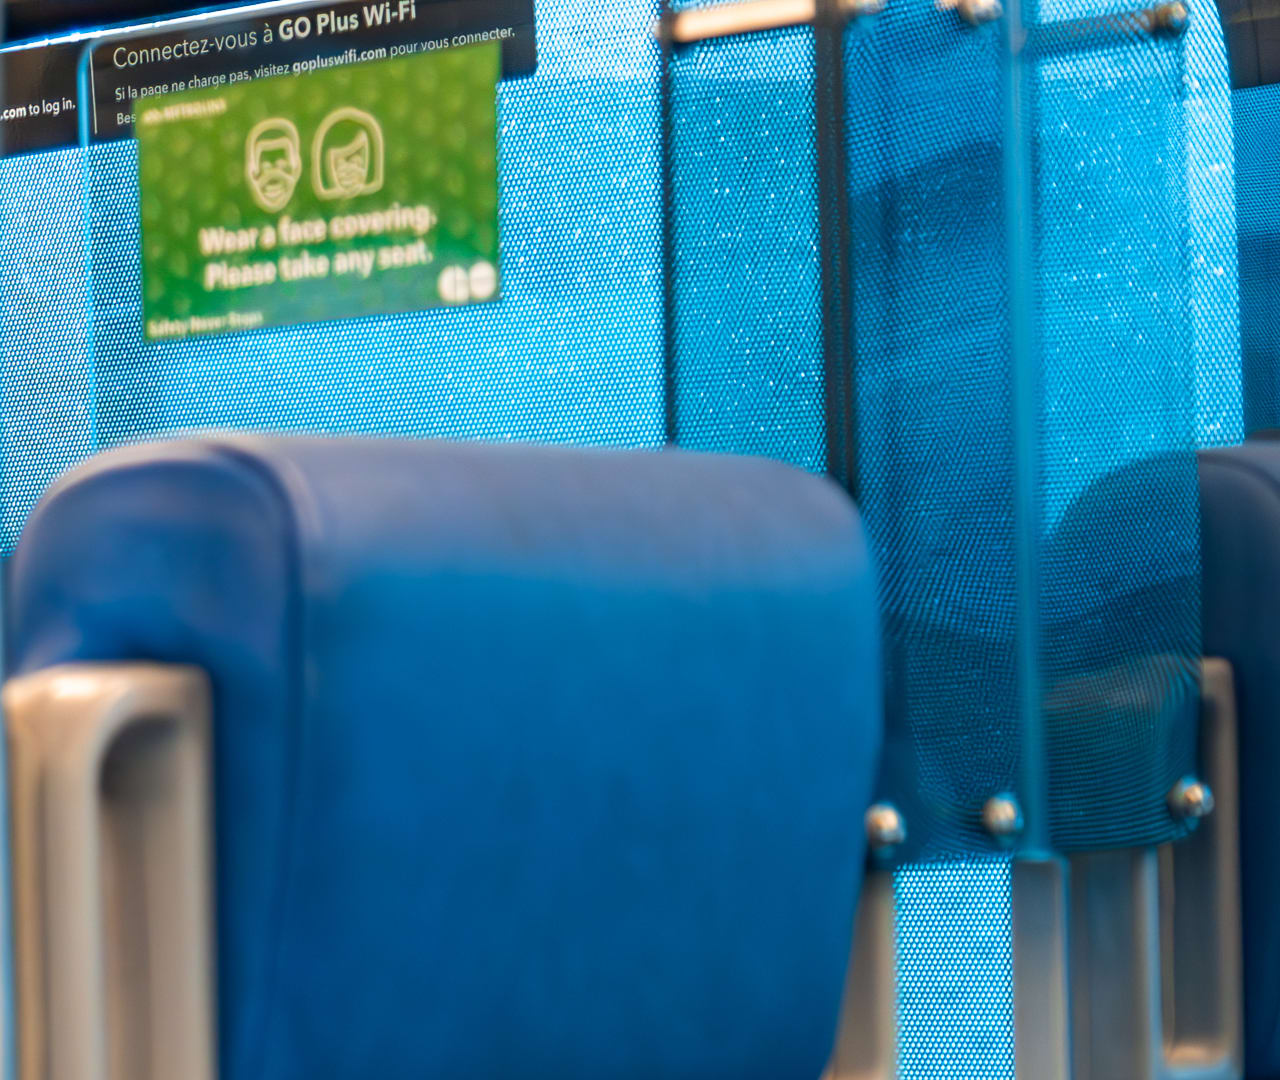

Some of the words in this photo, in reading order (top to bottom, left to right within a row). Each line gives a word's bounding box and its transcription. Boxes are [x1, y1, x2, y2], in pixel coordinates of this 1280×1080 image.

[113, 31, 258, 69] Connectez-vous
[263, 23, 274, 44] à
[278, 16, 311, 41] GO
[316, 10, 359, 36] Plus
[363, 0, 416, 28] Wi-Fi
[115, 87, 126, 101] Si
[128, 85, 138, 99] la
[141, 82, 168, 99] page
[171, 80, 185, 92] ne
[188, 73, 226, 90] charge
[229, 67, 252, 85] pas,
[254, 62, 290, 79] visitez
[292, 46, 387, 77] gopluswifi.com
[390, 41, 418, 59] pour
[420, 36, 449, 51] vous
[451, 26, 515, 48] connecter.
[28, 103, 40, 116] to
[42, 99, 60, 117] log
[62, 97, 76, 111] in.
[199, 226, 258, 256] Wear
[260, 225, 276, 248] a
[278, 214, 328, 246] face
[330, 202, 436, 239] covering.
[203, 261, 277, 292] Please
[278, 250, 330, 282] take
[332, 249, 375, 279] any
[377, 239, 433, 271] seat.
